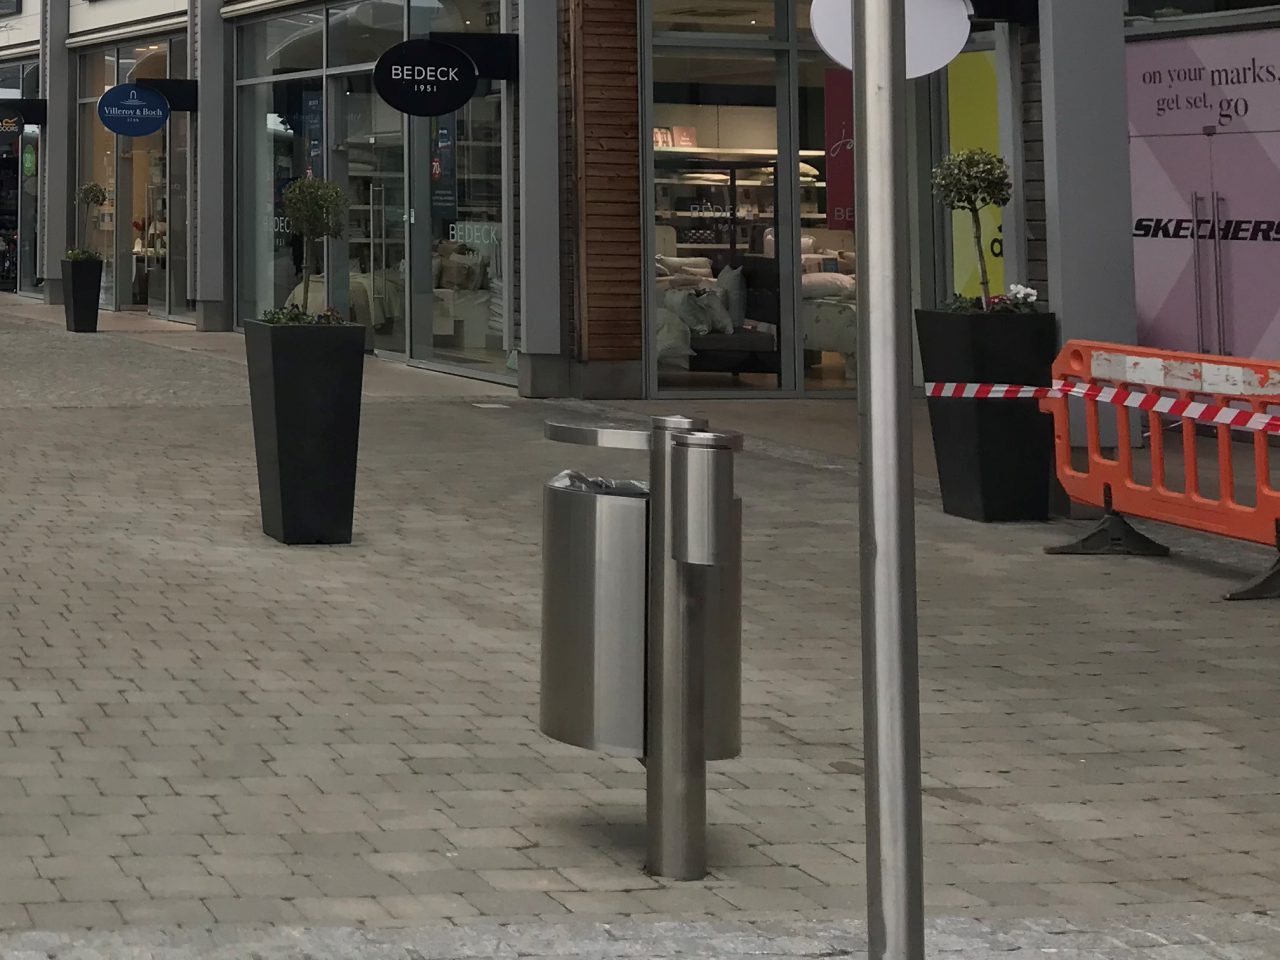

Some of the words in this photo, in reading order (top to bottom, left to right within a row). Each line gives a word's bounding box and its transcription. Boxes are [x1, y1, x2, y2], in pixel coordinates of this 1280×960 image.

[391, 65, 460, 82] BEDECK
[1142, 70, 1162, 85] on
[1168, 66, 1206, 88] your
[414, 84, 437, 92] 1951
[104, 106, 135, 116] Villeroy
[135, 108, 141, 116] &
[142, 108, 163, 117] Boch
[1156, 94, 1181, 117] get
[1186, 91, 1214, 111] set,
[1217, 96, 1249, 127] go
[449, 223, 498, 244] BEDECK
